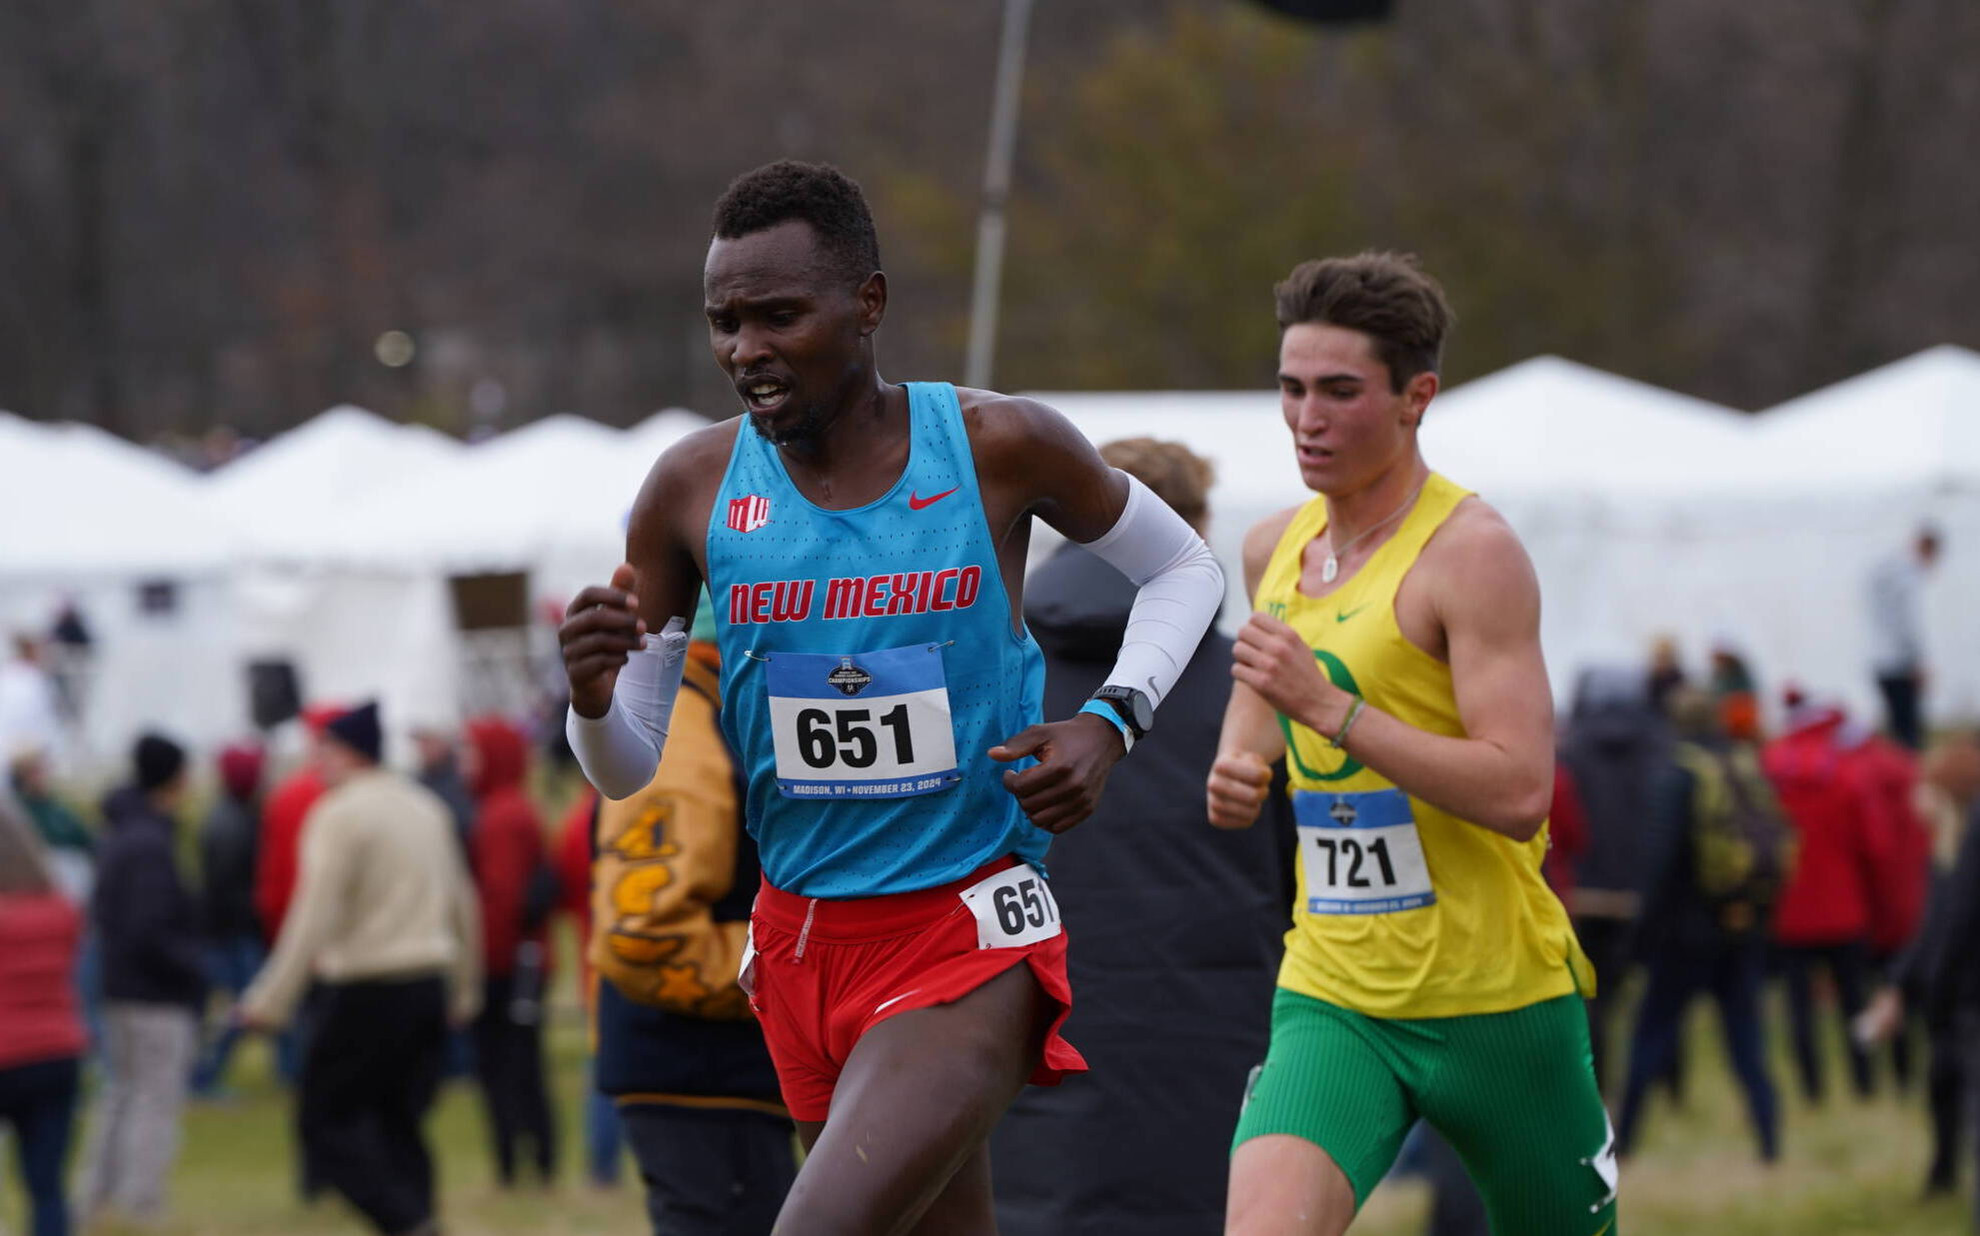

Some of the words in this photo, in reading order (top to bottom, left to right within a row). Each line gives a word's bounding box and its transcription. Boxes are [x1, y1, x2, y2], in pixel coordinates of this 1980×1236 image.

[729, 580, 815, 625] NEW
[823, 565, 982, 619] MEXICO
[796, 704, 914, 769] 651
[793, 784, 833, 795] MADISON,
[835, 784, 846, 794] WI
[852, 784, 898, 795] NOVEMBER
[900, 783, 915, 793] 23,
[917, 777, 942, 790] 2024
[1316, 836, 1396, 888] 721
[993, 878, 1054, 936] 651
